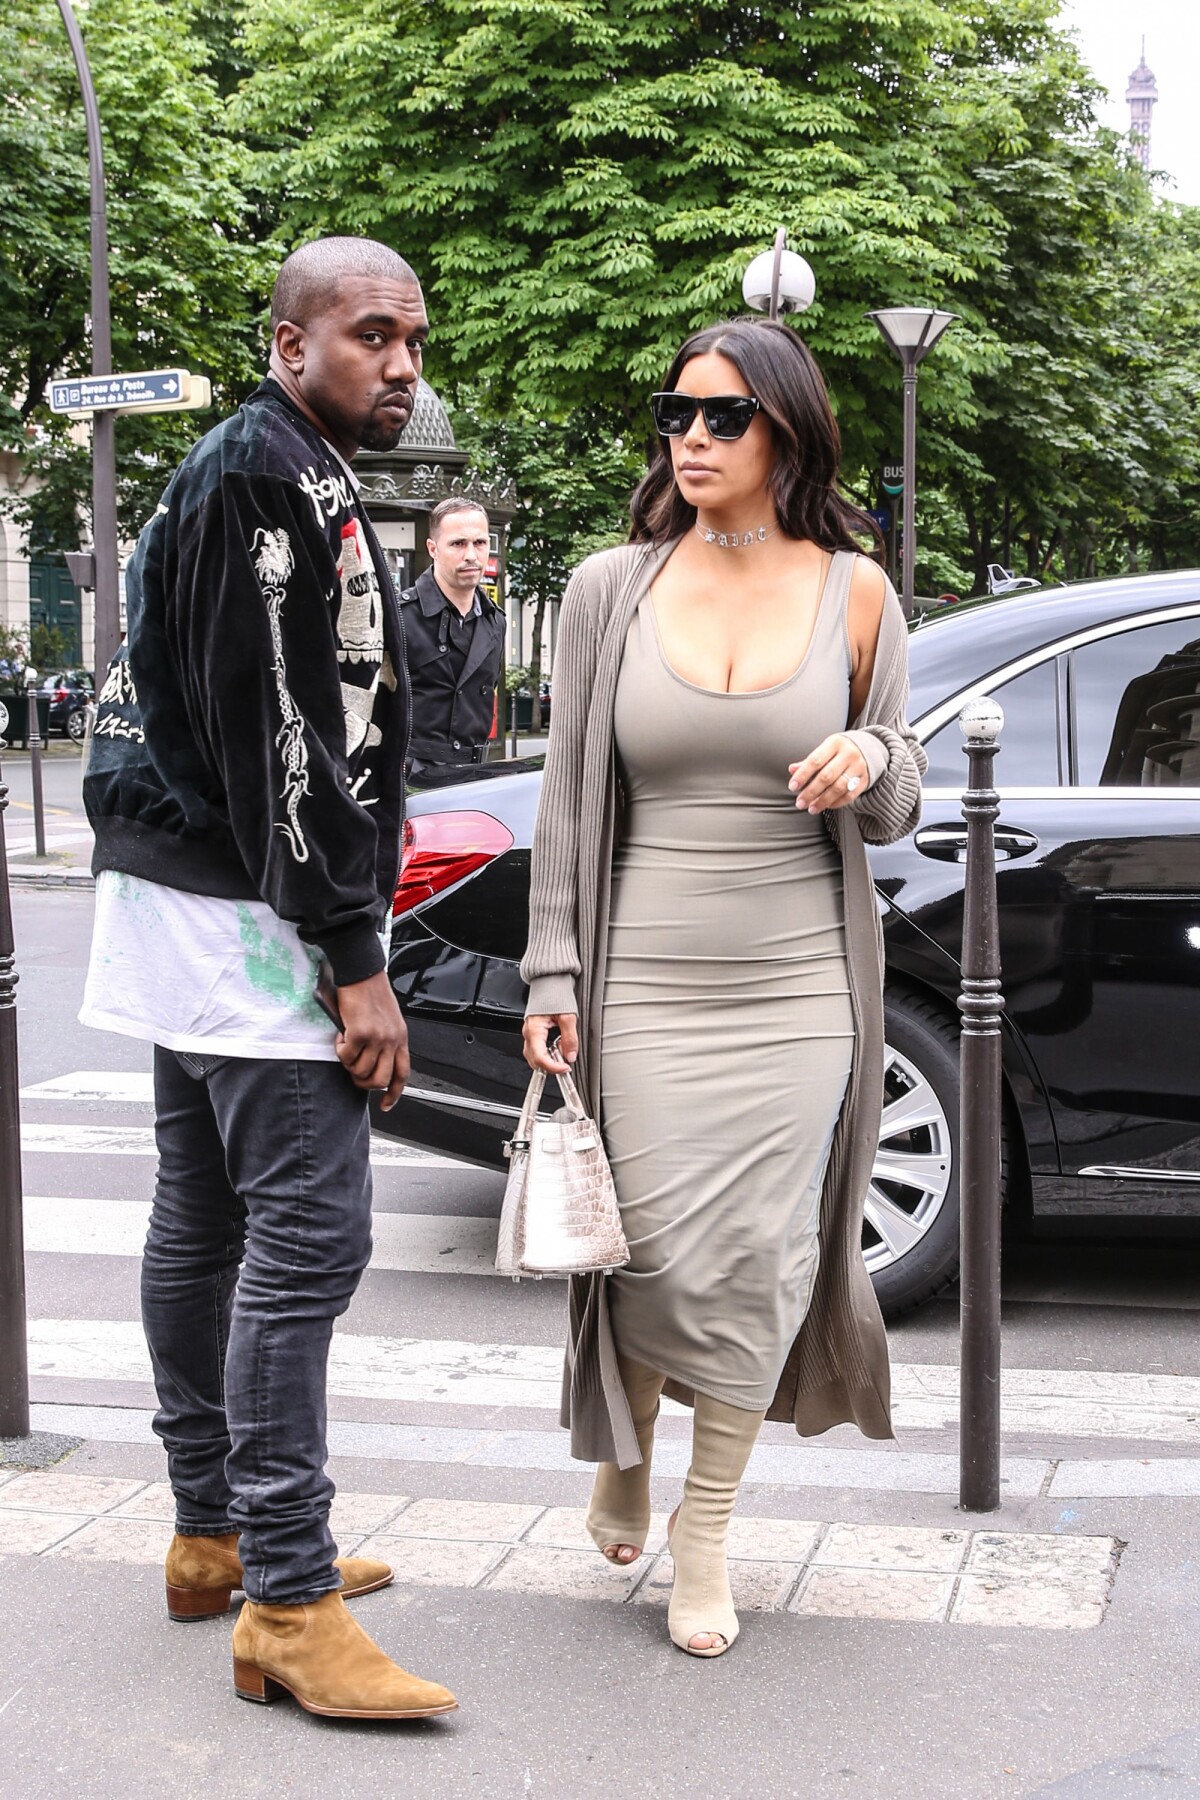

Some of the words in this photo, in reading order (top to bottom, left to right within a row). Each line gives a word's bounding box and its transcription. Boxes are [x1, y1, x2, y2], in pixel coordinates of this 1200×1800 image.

[81, 384, 108, 395] Bureau
[110, 381, 120, 392] de
[123, 380, 145, 391] Poste
[94, 394, 106, 404] Rue
[108, 393, 116, 402] de
[117, 392, 124, 401] la
[884, 466, 904, 478] BUS
